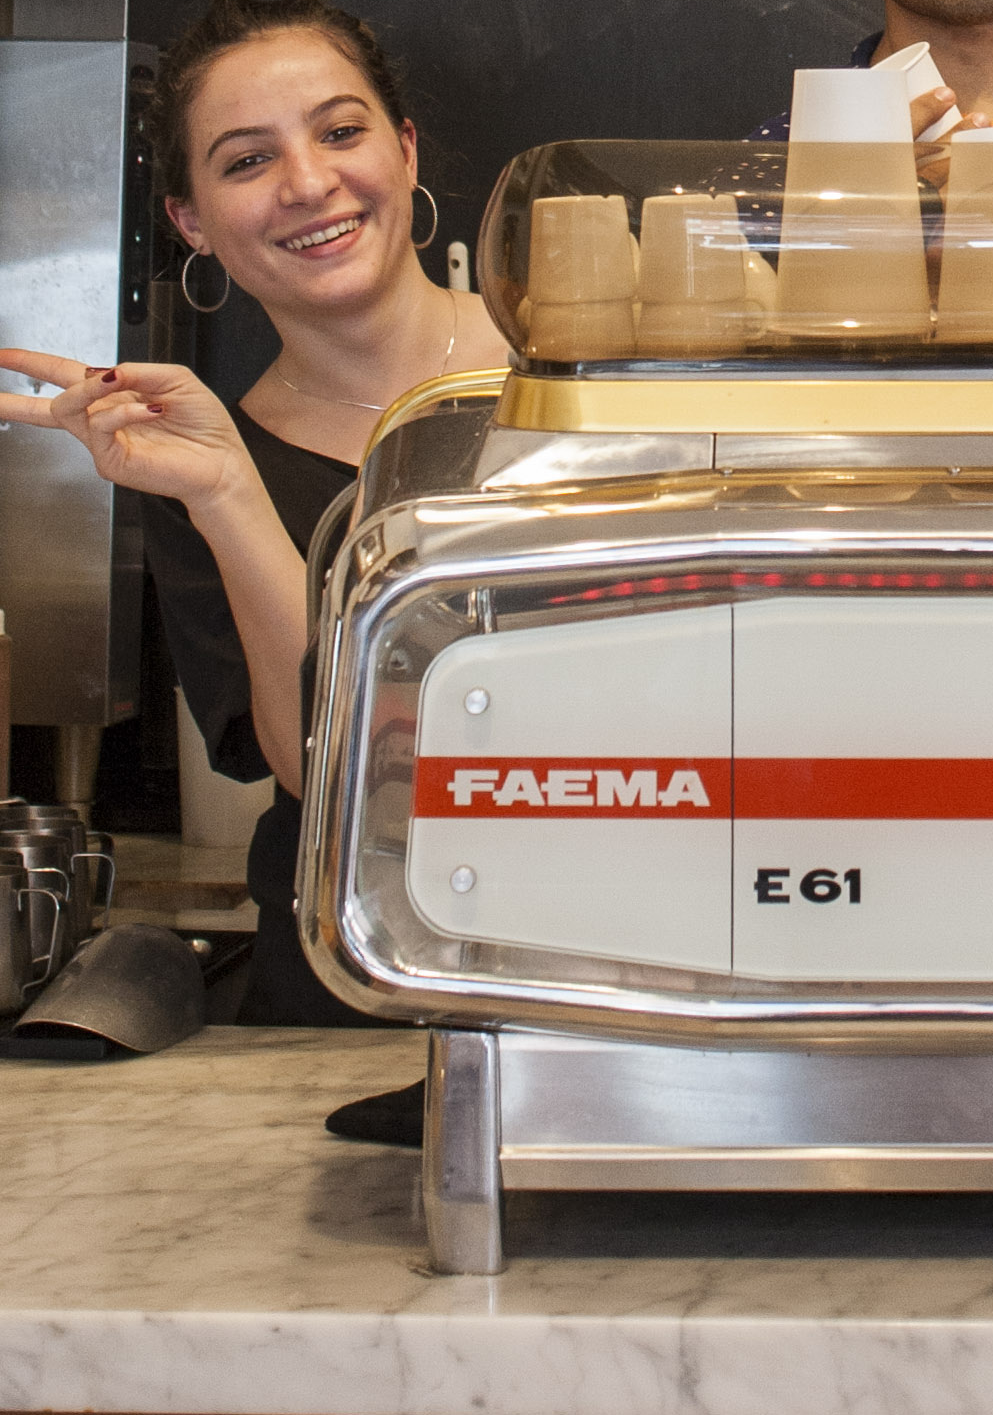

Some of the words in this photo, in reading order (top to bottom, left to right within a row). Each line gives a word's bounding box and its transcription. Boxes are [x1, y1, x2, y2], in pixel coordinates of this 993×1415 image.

[448, 769, 711, 807] FAEMA
[754, 868, 790, 904] E
[800, 868, 862, 904] 61
